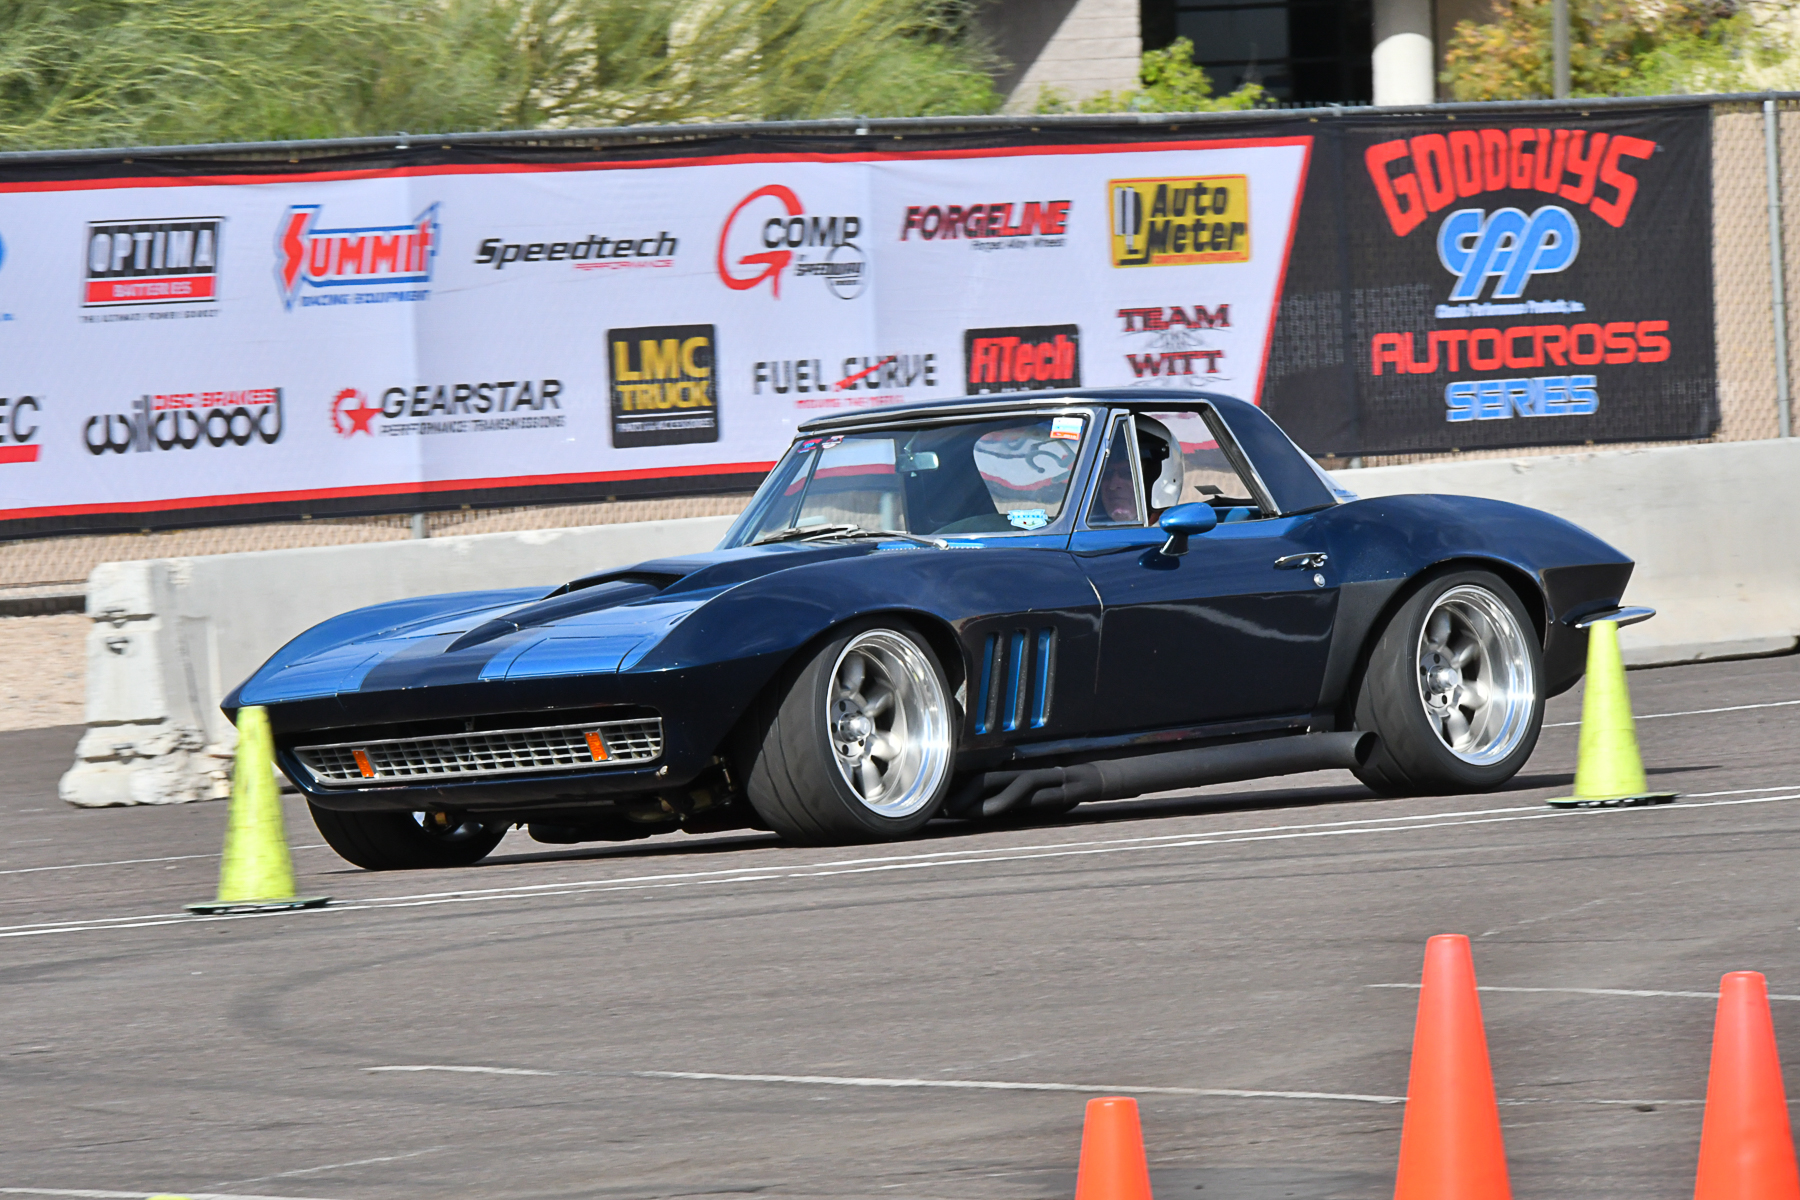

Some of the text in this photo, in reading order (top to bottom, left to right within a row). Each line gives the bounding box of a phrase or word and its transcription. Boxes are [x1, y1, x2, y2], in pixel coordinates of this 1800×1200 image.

[1150, 183, 1228, 218] Auto
[1364, 128, 1657, 237] GOODGUYS
[900, 200, 1073, 241] FORGELINE
[1149, 217, 1247, 254] Meter
[88, 230, 215, 273] OPTIMA
[476, 231, 679, 270] Speedtech
[1117, 304, 1232, 333] TEAM
[613, 337, 709, 381] LMC
[1126, 350, 1225, 378] WITT
[1372, 320, 1671, 376] AUTOCROSS
[754, 352, 939, 395] FUEL CURVE
[381, 379, 564, 419] GEARSTAR
[616, 381, 712, 413] TRUCK
[1446, 375, 1600, 423] SERIES
[85, 387, 283, 455] wilwood
